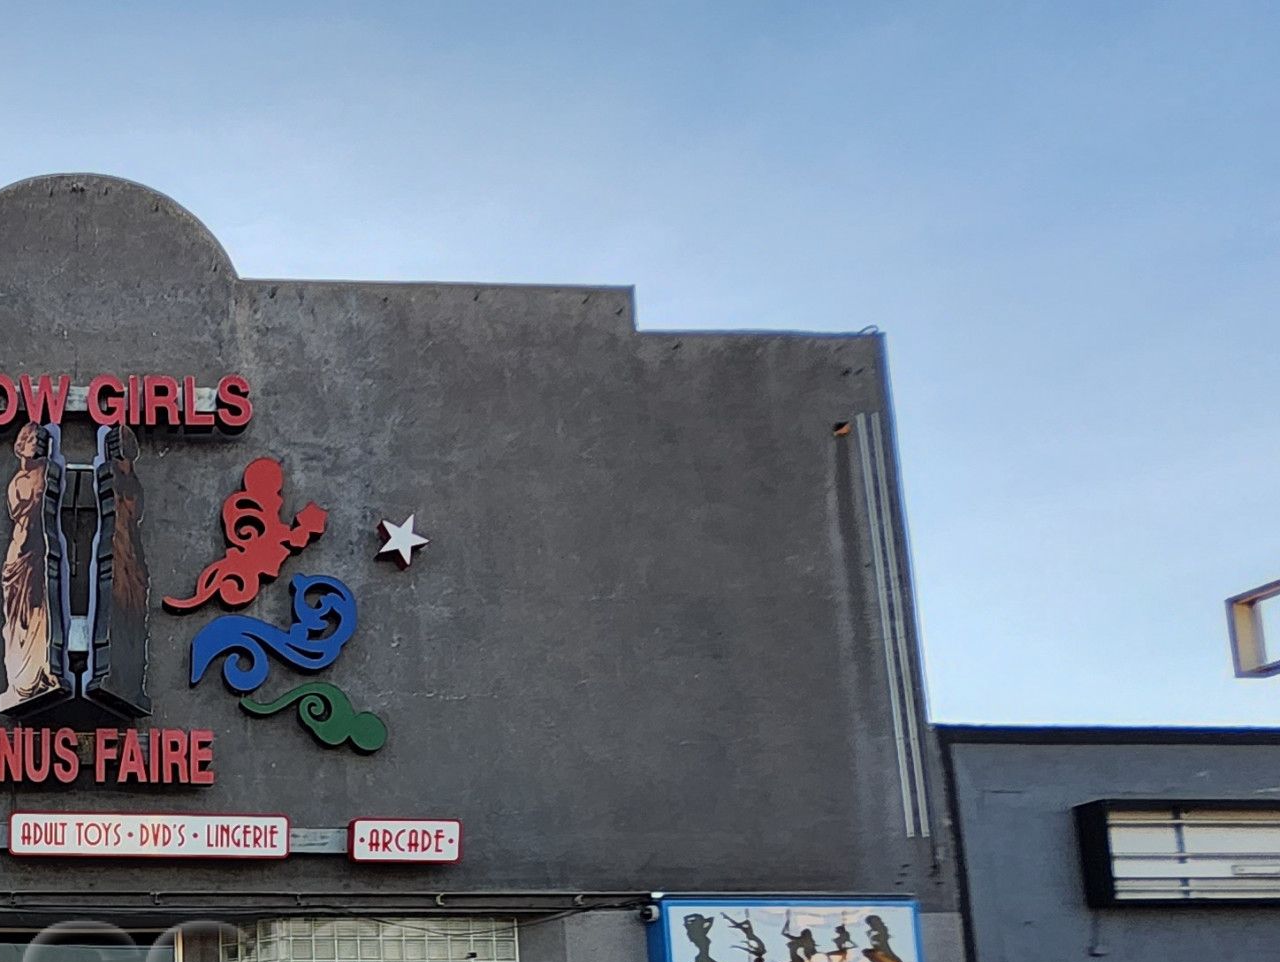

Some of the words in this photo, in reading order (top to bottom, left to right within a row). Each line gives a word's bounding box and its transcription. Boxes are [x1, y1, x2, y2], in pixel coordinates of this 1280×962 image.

[86, 374, 254, 427] GIRLS
[95, 728, 215, 785] FAIRE
[21, 822, 68, 846] ADULT
[75, 822, 122, 846] TOYS
[139, 823, 186, 848] DVD'S
[206, 824, 279, 848] LINGERIE
[368, 828, 445, 852] ARCADE
